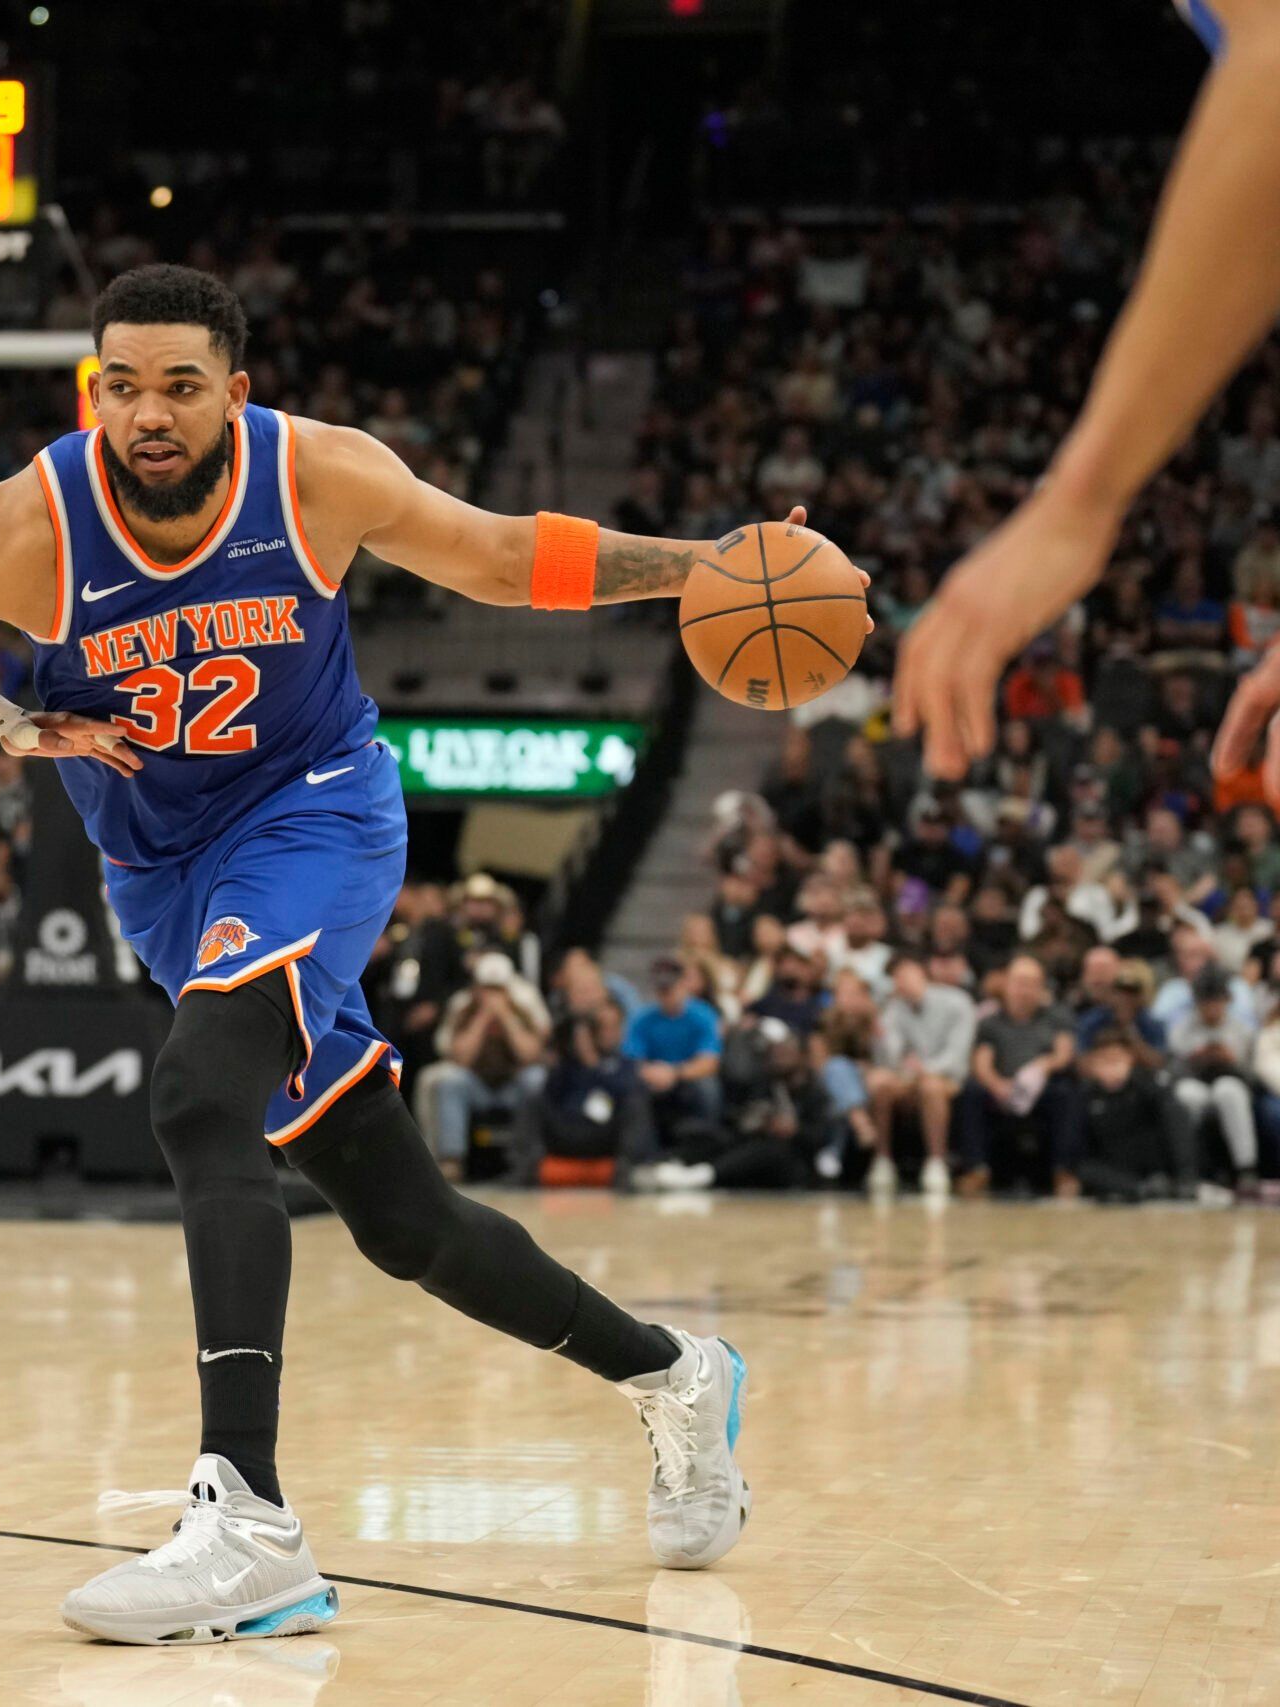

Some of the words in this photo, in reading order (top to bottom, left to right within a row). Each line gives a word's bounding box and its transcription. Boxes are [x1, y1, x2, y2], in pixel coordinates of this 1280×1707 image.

[227, 546, 252, 559] abu
[251, 536, 287, 554] dhabi
[80, 610, 179, 677] NEW
[181, 596, 305, 652] YORK
[110, 653, 261, 754] 32
